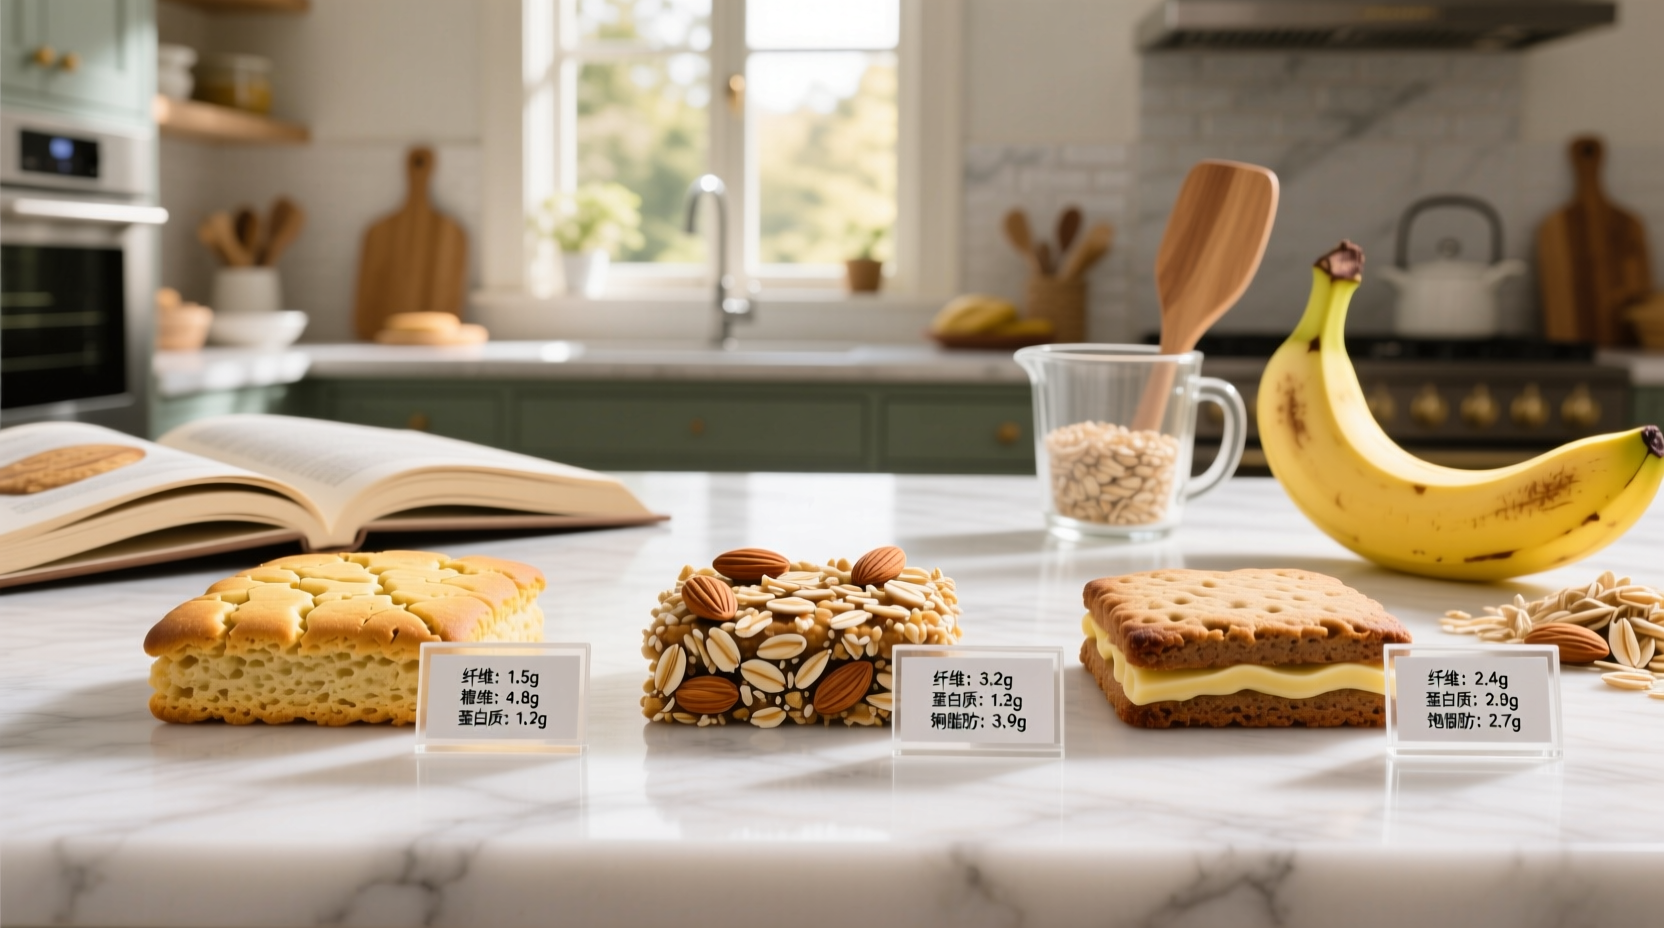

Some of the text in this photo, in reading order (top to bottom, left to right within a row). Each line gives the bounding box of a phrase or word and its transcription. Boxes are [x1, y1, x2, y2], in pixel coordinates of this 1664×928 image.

[508, 670, 539, 688] 1.5g
[979, 671, 1013, 691] 3.2g
[1475, 671, 1508, 690] 2.4g
[506, 690, 539, 709] 4.8g
[991, 693, 1023, 711] 1.2g
[516, 711, 547, 729] 1.2g
[992, 713, 1027, 732] 3.9g
[1489, 713, 1521, 733] 2.7g
